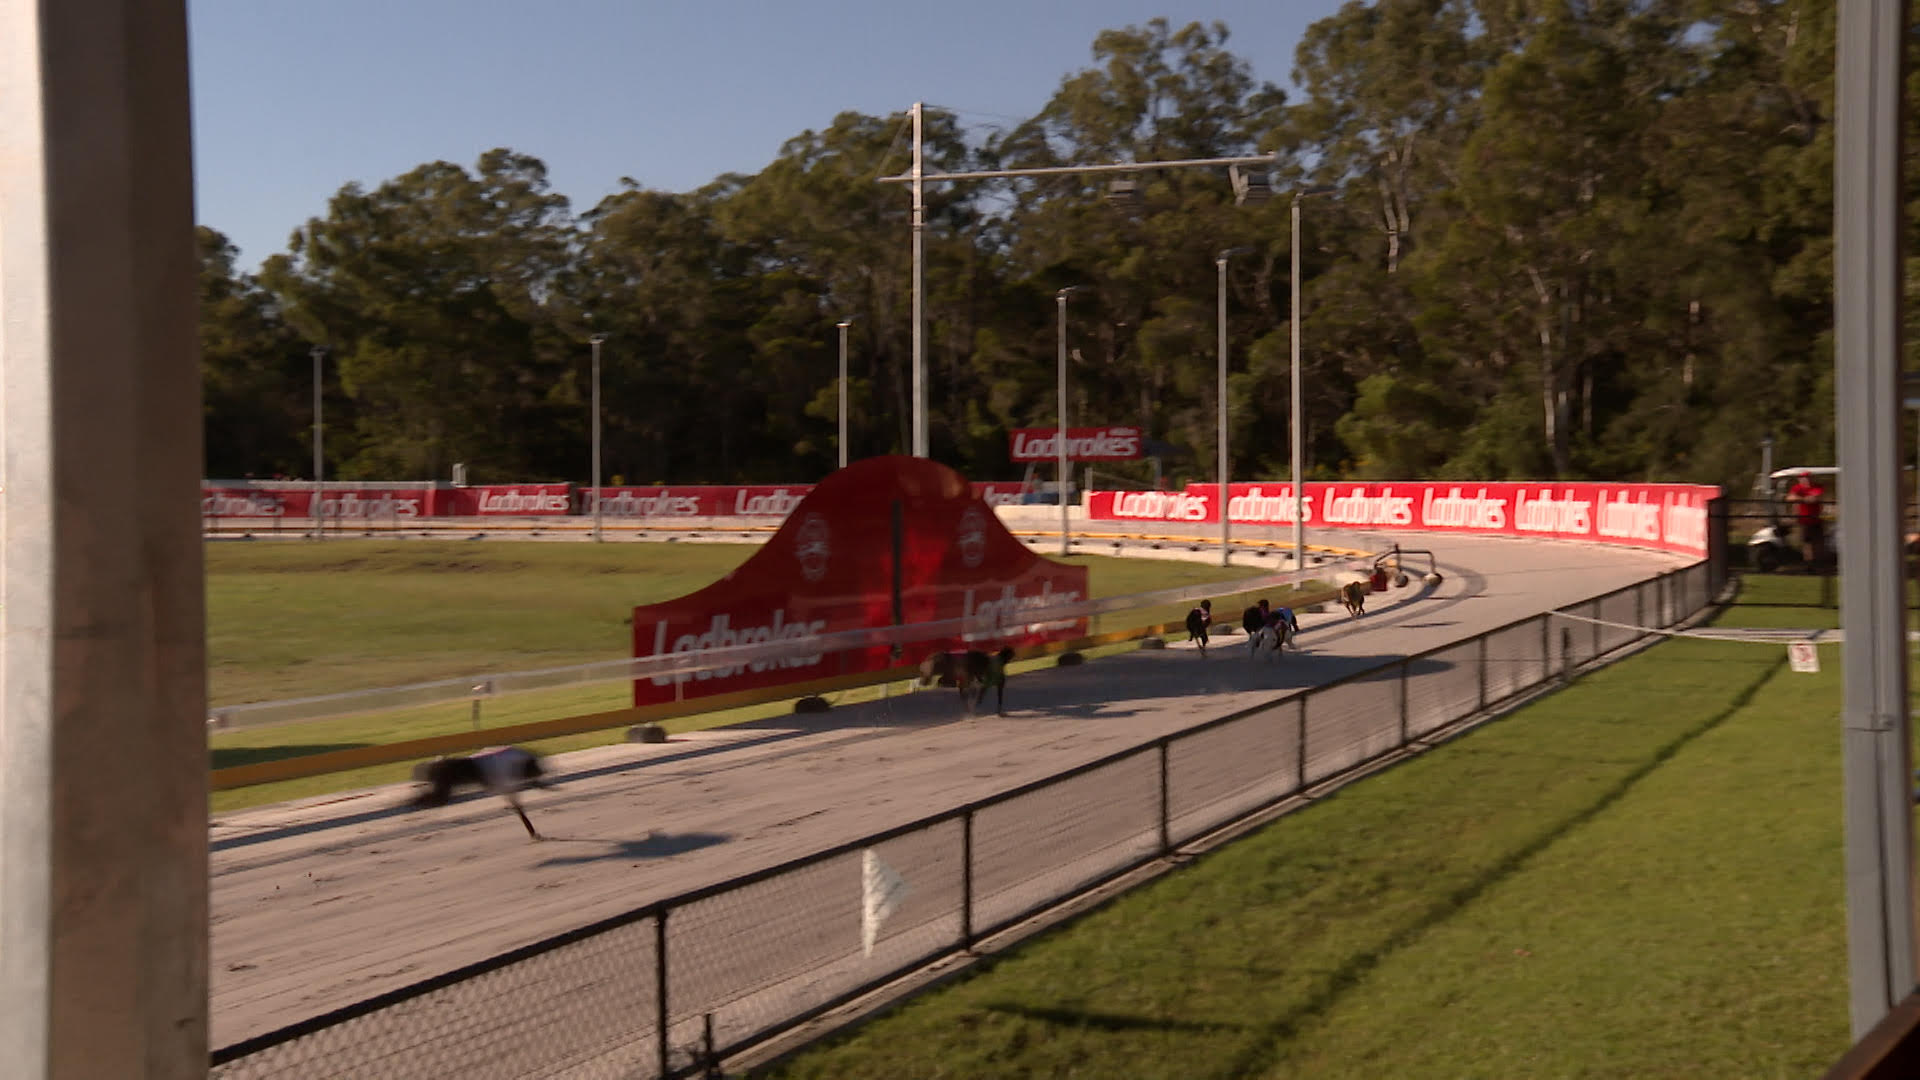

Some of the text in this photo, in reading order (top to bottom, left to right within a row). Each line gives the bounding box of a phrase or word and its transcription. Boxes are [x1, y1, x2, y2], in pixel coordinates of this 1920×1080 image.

[478, 489, 570, 512] Ladbrokes
[1228, 487, 1314, 522] adbrokes
[1323, 487, 1413, 524] Ladbrokes
[1422, 487, 1507, 528] Ladbrokes
[1515, 489, 1592, 534] Ladbrokes
